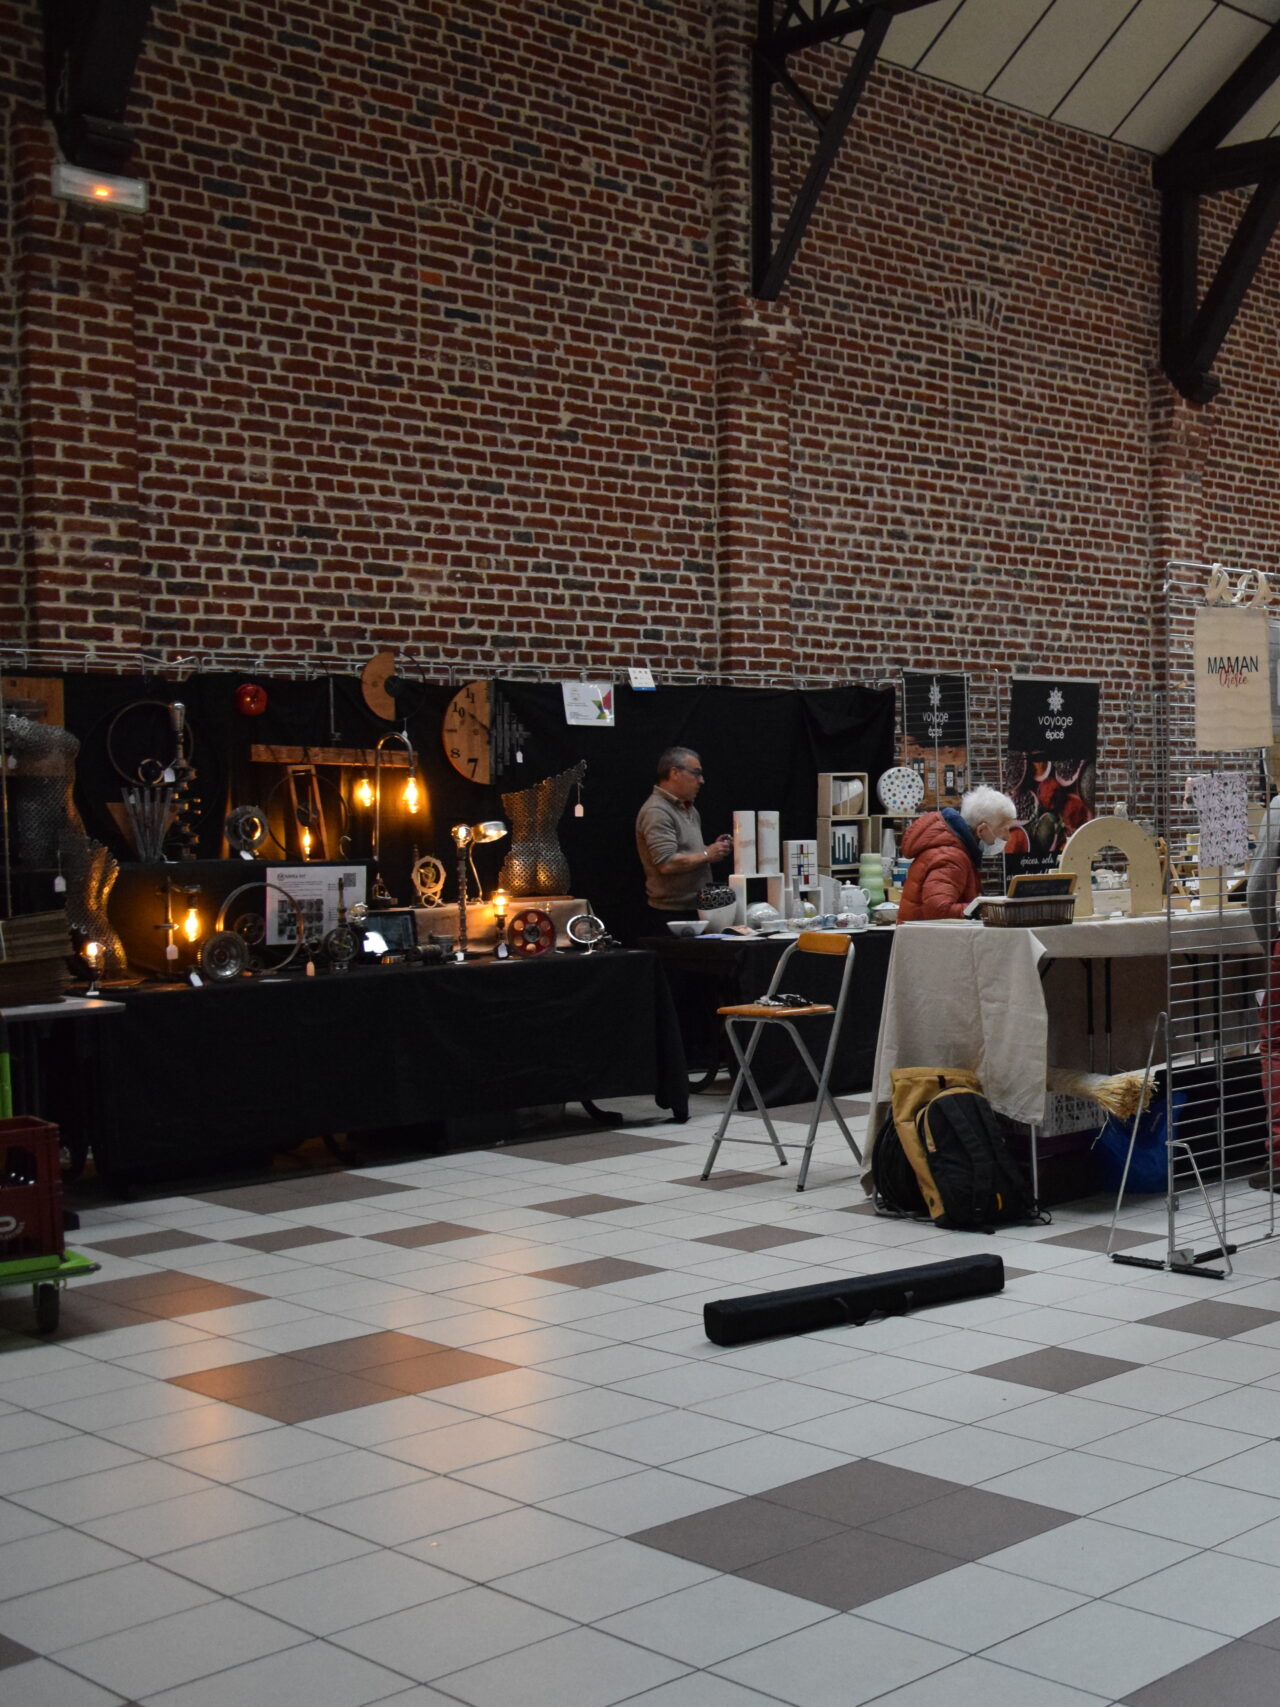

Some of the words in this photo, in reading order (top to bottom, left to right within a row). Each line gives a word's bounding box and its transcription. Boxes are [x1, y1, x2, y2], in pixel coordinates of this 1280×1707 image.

[1207, 655, 1259, 674] MAMAN
[922, 711, 949, 726] voyage
[1037, 714, 1074, 729] voyage
[467, 758, 478, 778] 7
